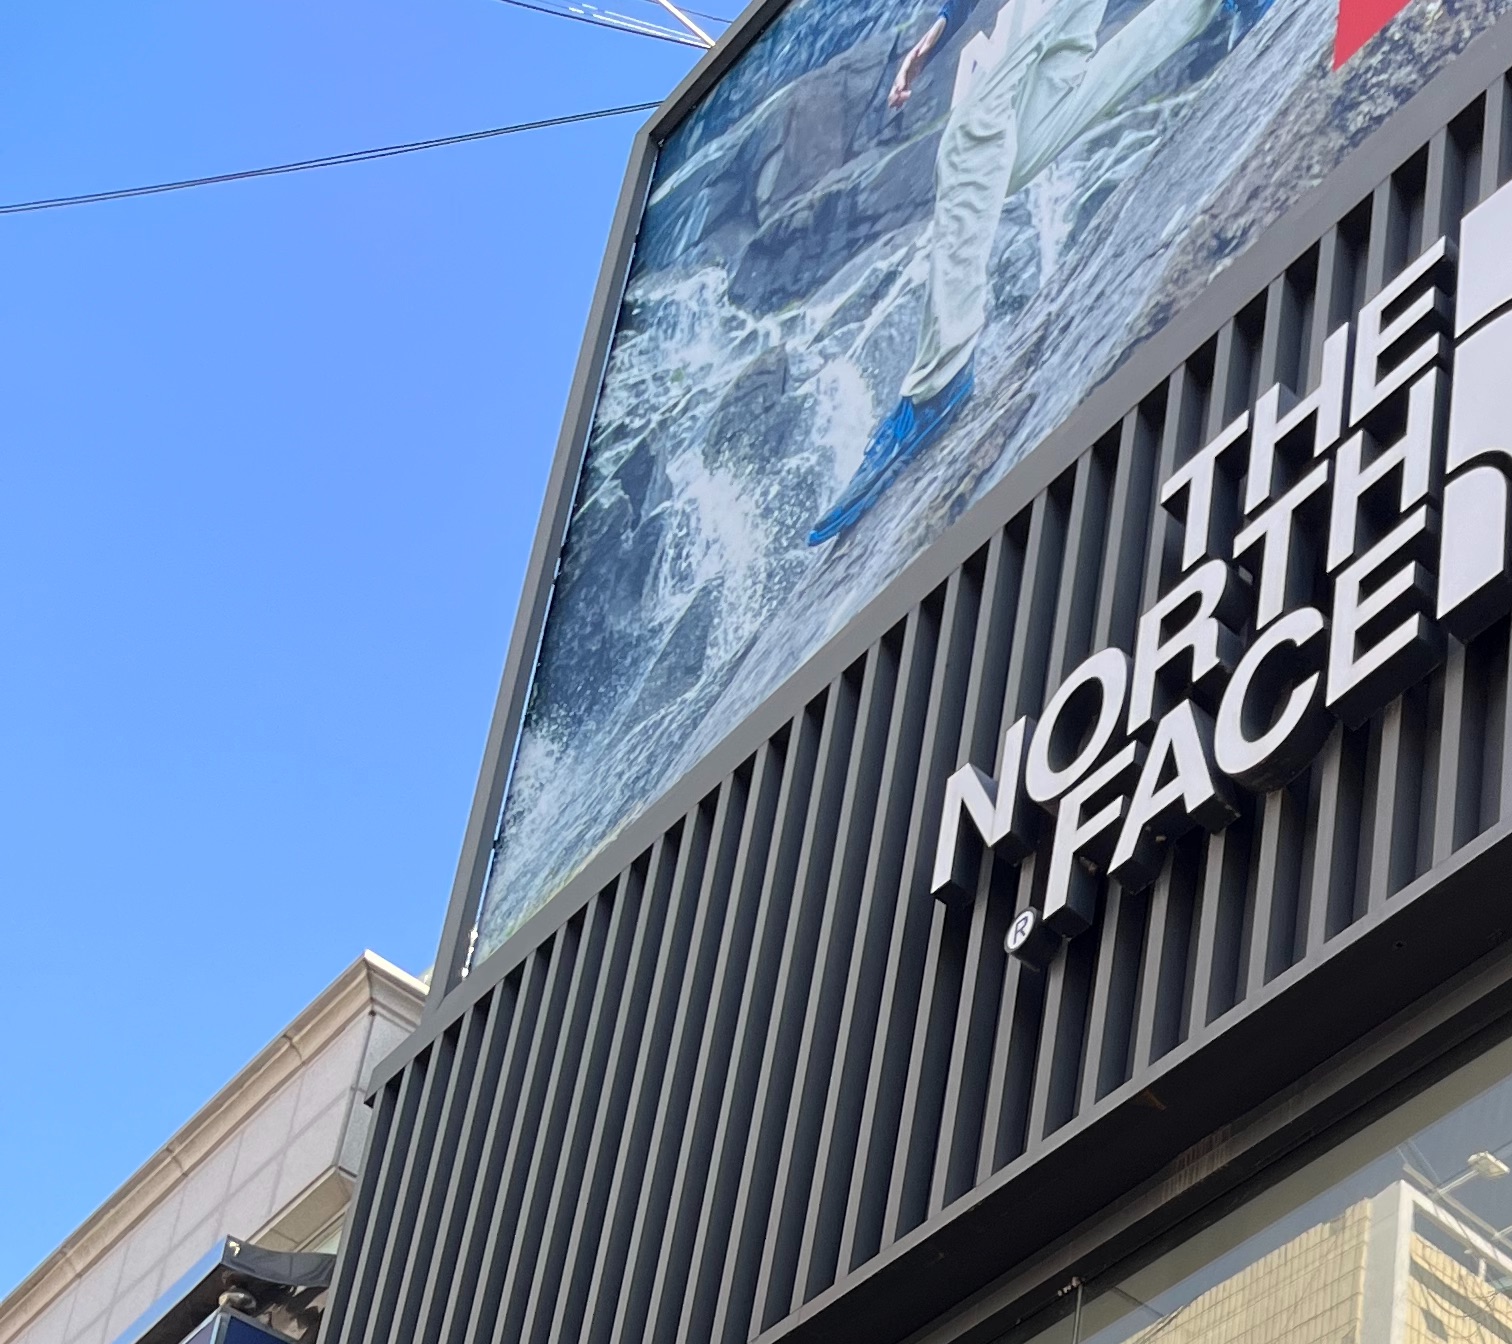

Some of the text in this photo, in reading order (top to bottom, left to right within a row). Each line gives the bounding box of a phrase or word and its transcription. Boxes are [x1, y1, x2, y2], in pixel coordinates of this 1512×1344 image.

[1161, 236, 1448, 571] THE
[930, 368, 1438, 896] NORTH
[1042, 502, 1432, 922] FACE
